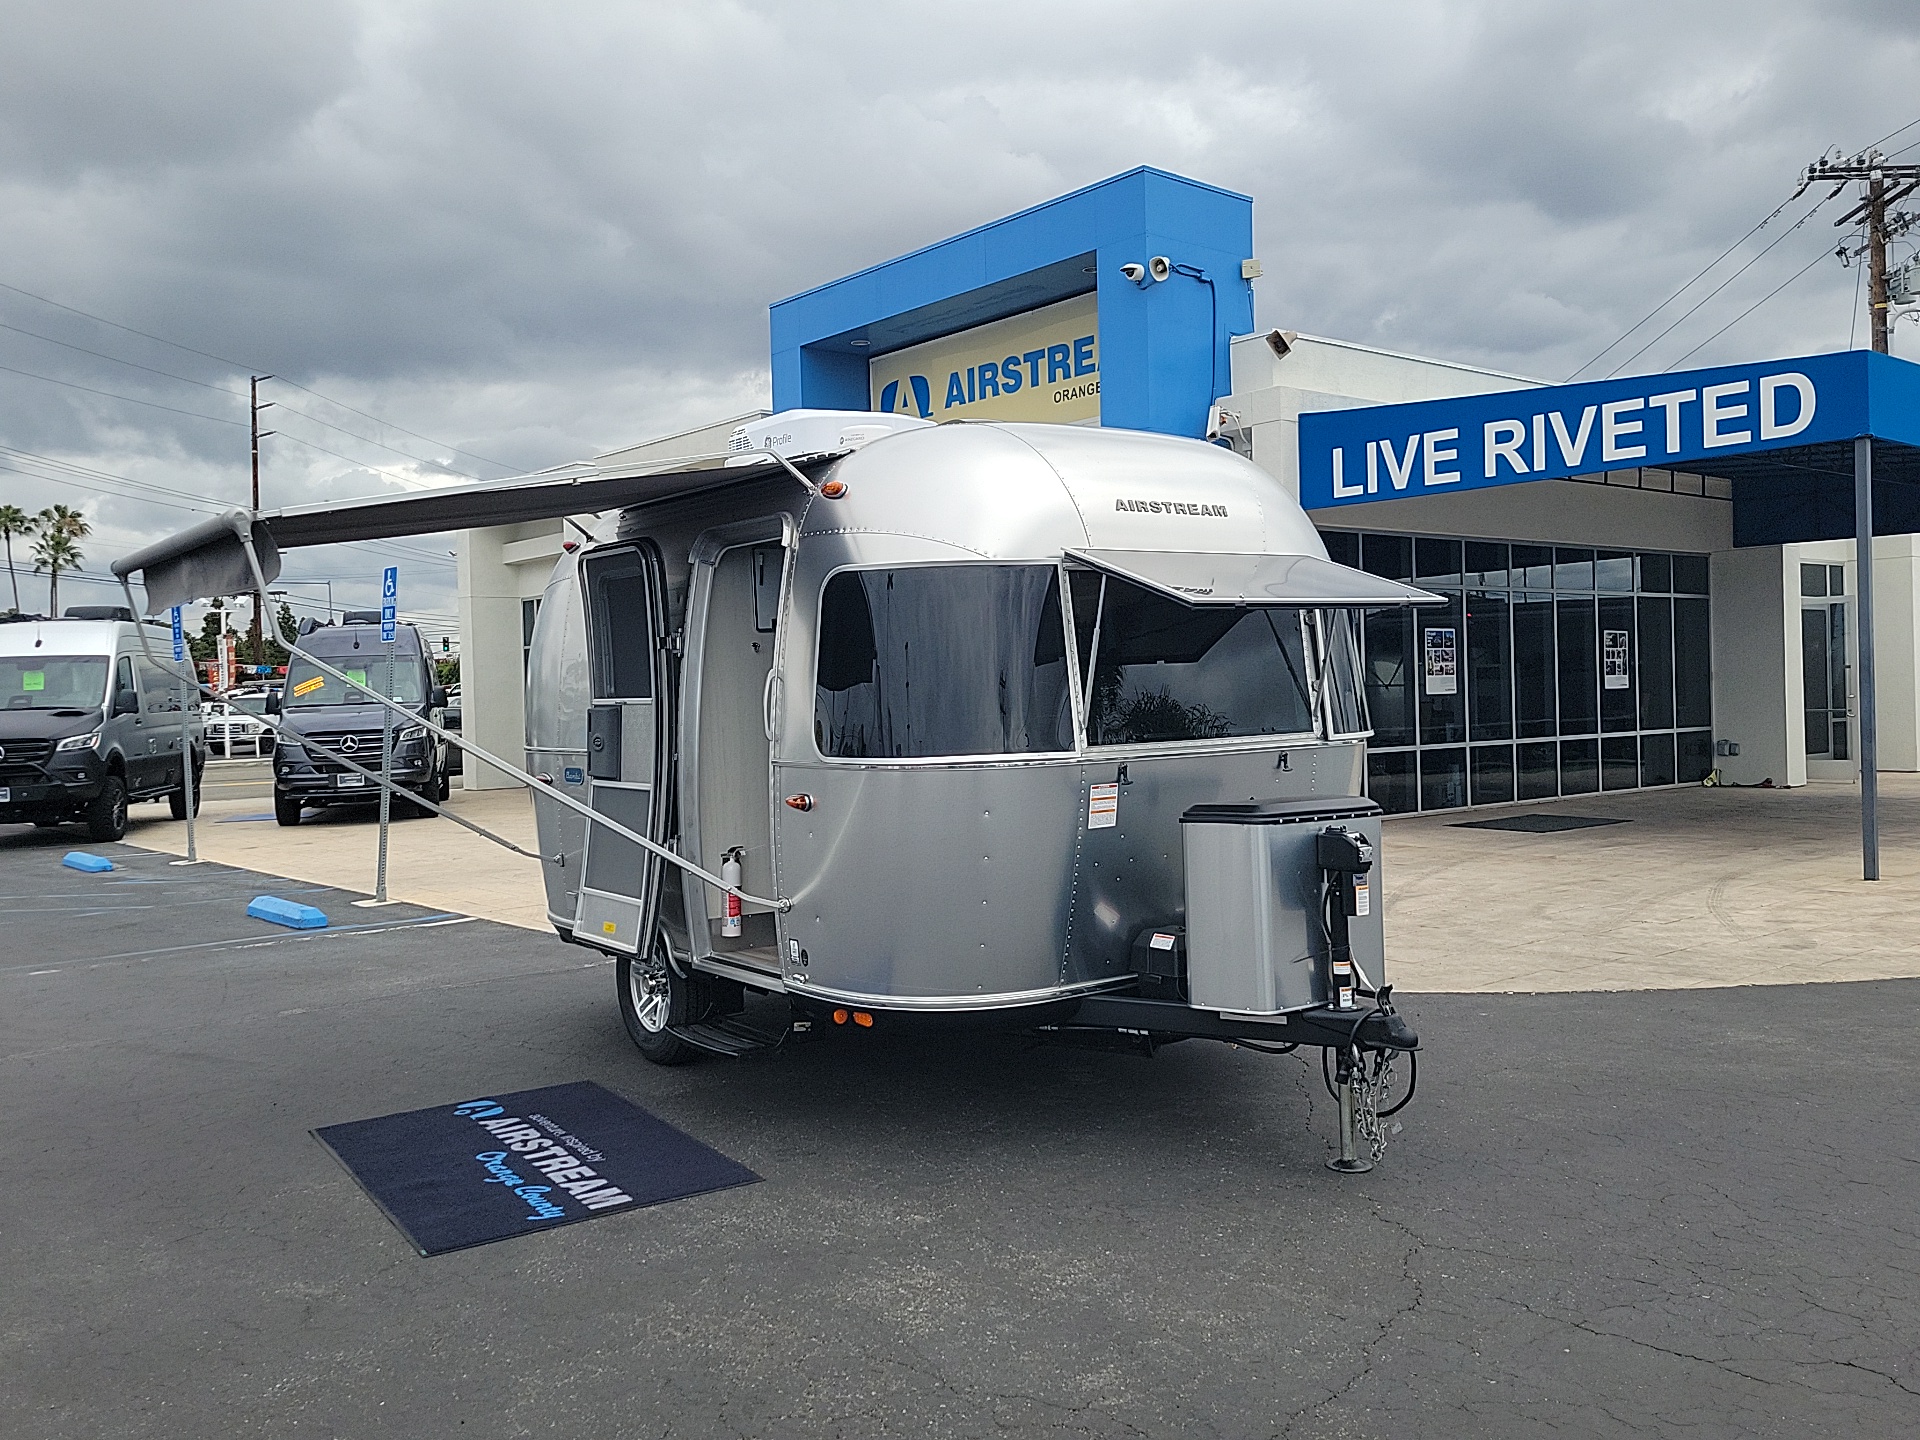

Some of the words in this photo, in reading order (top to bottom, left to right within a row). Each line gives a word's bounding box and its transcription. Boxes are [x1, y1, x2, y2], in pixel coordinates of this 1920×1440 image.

[944, 334, 1099, 409] AIRSTRE
[772, 433, 792, 446] Profile
[1332, 427, 1461, 499] LIVE
[1483, 372, 1817, 478] RIVETED
[1115, 498, 1228, 517] AIRSTREAM
[475, 1151, 525, 1187] Orange
[513, 1185, 566, 1220] County
[478, 1117, 634, 1211] AIRSTREAM
